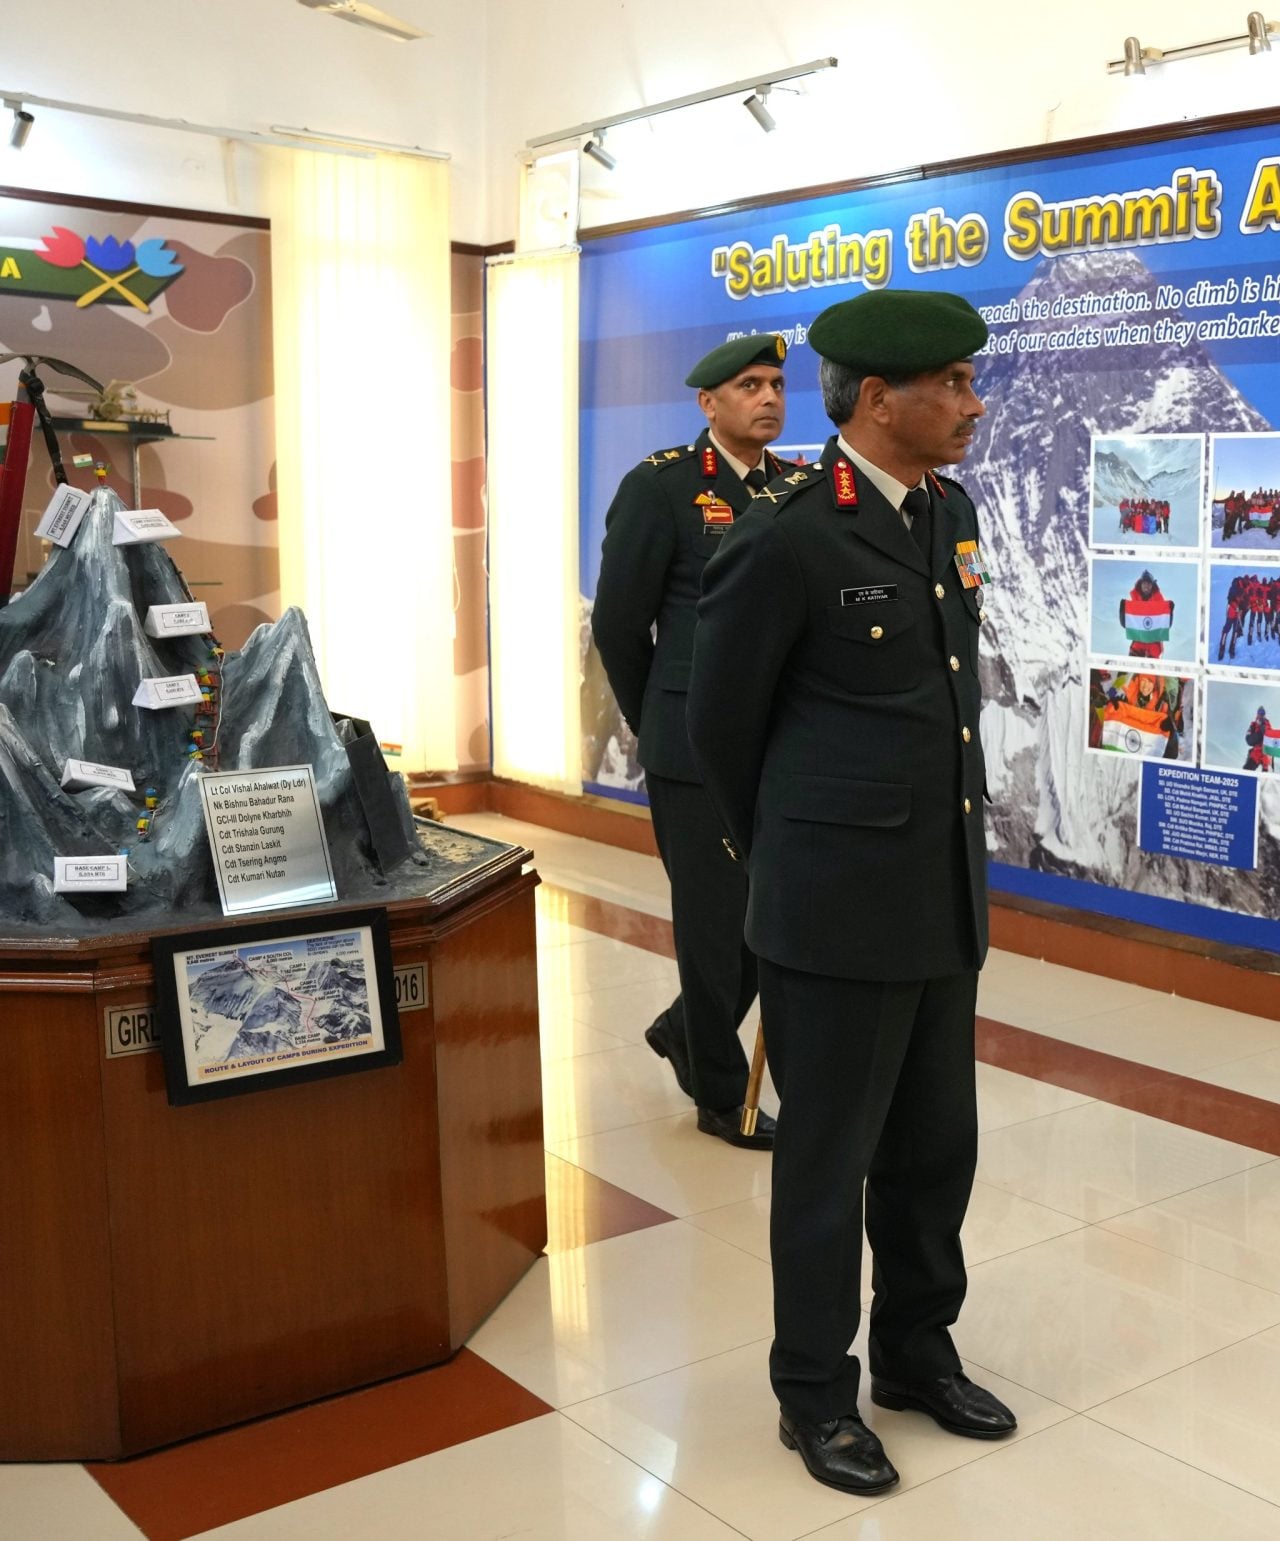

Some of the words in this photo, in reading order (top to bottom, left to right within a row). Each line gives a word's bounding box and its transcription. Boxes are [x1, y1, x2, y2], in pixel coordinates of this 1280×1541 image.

[713, 226, 891, 299] "Saluting
[906, 209, 986, 273] the
[1005, 169, 1221, 260] Summit
[0, 256, 23, 280] A
[794, 322, 806, 345] is
[978, 298, 1020, 324] reach
[1023, 297, 1049, 321] the
[1052, 289, 1152, 316] destination.
[1156, 285, 1183, 309] No
[1185, 278, 1239, 307] climb
[1241, 276, 1260, 303] is
[999, 329, 1018, 351] of
[1018, 334, 1047, 351] our
[1049, 325, 1100, 349] cadets
[1104, 321, 1150, 346] when
[1154, 318, 1194, 347] they
[1159, 768, 1199, 781] EXPEDITION
[1201, 774, 1239, 787] TEAM-2025
[210, 787, 218, 796] Lt
[219, 785, 231, 795] Col
[231, 783, 253, 793] Vishal
[253, 782, 279, 791] Ahalwat
[213, 801, 223, 810] Nk
[224, 800, 248, 809] Bishnu
[249, 797, 276, 807] Bahadur
[277, 794, 294, 803] Rana
[219, 830, 232, 840] Cdt
[232, 827, 259, 837] Trishala
[260, 826, 285, 835] Gurung
[222, 844, 234, 854] Cdt
[235, 843, 260, 853] Stanzin
[224, 860, 237, 869] Cdt
[238, 857, 263, 867] Tsering
[264, 855, 287, 865] Angmo
[227, 874, 240, 884] Cdt
[240, 871, 265, 882] Kumari
[266, 870, 286, 878] Nutan
[394, 973, 418, 1003] 016
[204, 1065, 229, 1074] ROUTE
[237, 1058, 264, 1068] LAYOUT
[277, 1052, 300, 1061] CAMPS
[329, 1040, 368, 1051] EXPEDITION
